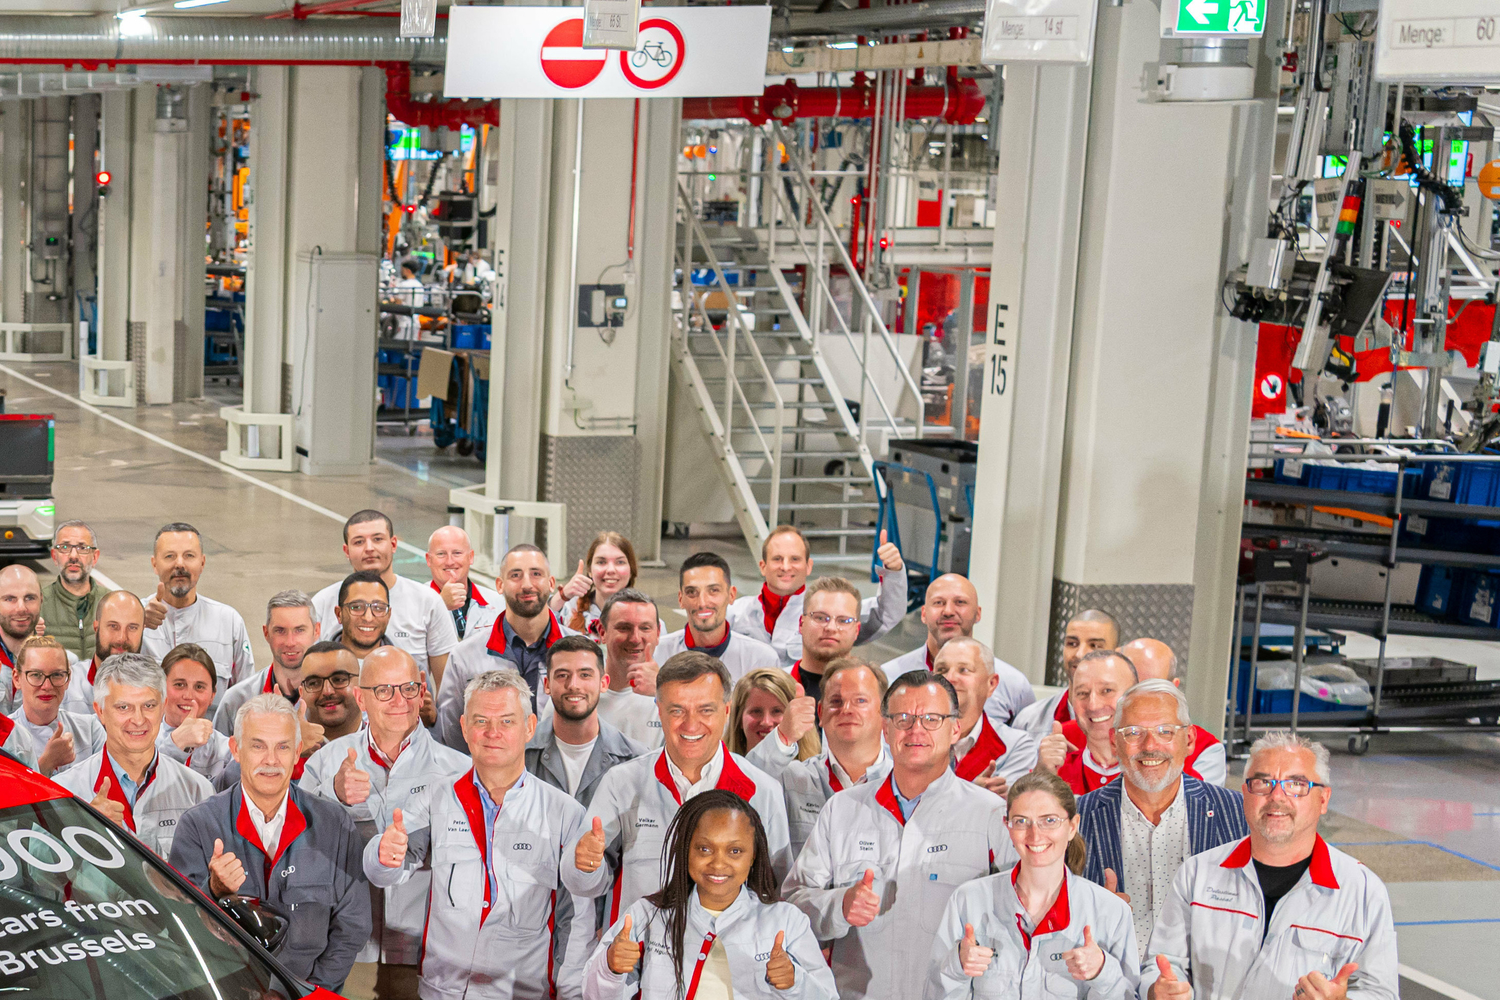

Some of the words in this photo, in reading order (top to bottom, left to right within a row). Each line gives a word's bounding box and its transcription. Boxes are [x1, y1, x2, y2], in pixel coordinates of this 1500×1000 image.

[1400, 24, 1446, 48] Menge:
[1476, 17, 1495, 40] 60
[994, 303, 1008, 345] E
[991, 354, 1008, 395] 15
[64, 897, 159, 928] from
